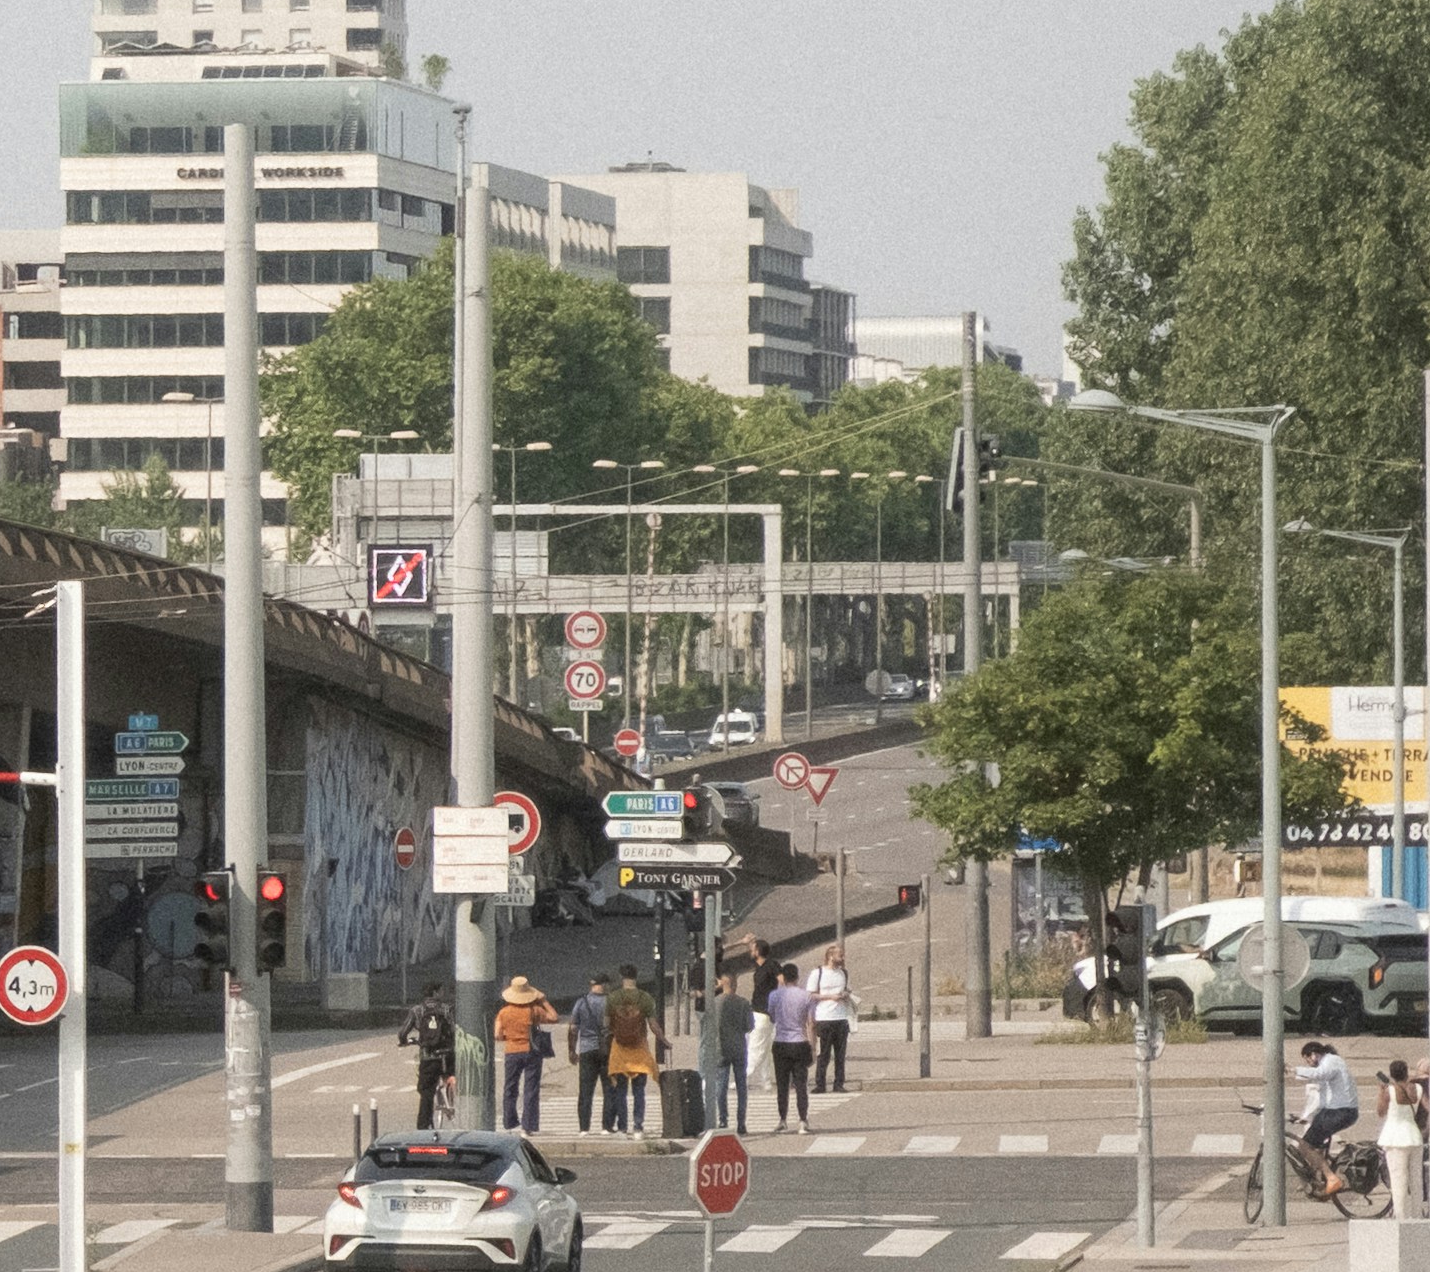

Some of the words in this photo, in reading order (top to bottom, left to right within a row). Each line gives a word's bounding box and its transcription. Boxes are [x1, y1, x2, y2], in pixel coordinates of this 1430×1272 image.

[574, 672, 597, 688] 70
[1348, 696, 1395, 712] Herm
[148, 737, 175, 748] PARIS
[1356, 769, 1414, 782] VENDE
[88, 784, 147, 795] MARSEILLE
[626, 798, 654, 810] PARIS
[1347, 822, 1373, 841] 42
[622, 847, 674, 858] GERLAND
[636, 872, 668, 884] TONY
[671, 872, 721, 885] GARNIER
[700, 1161, 745, 1188] STOP
